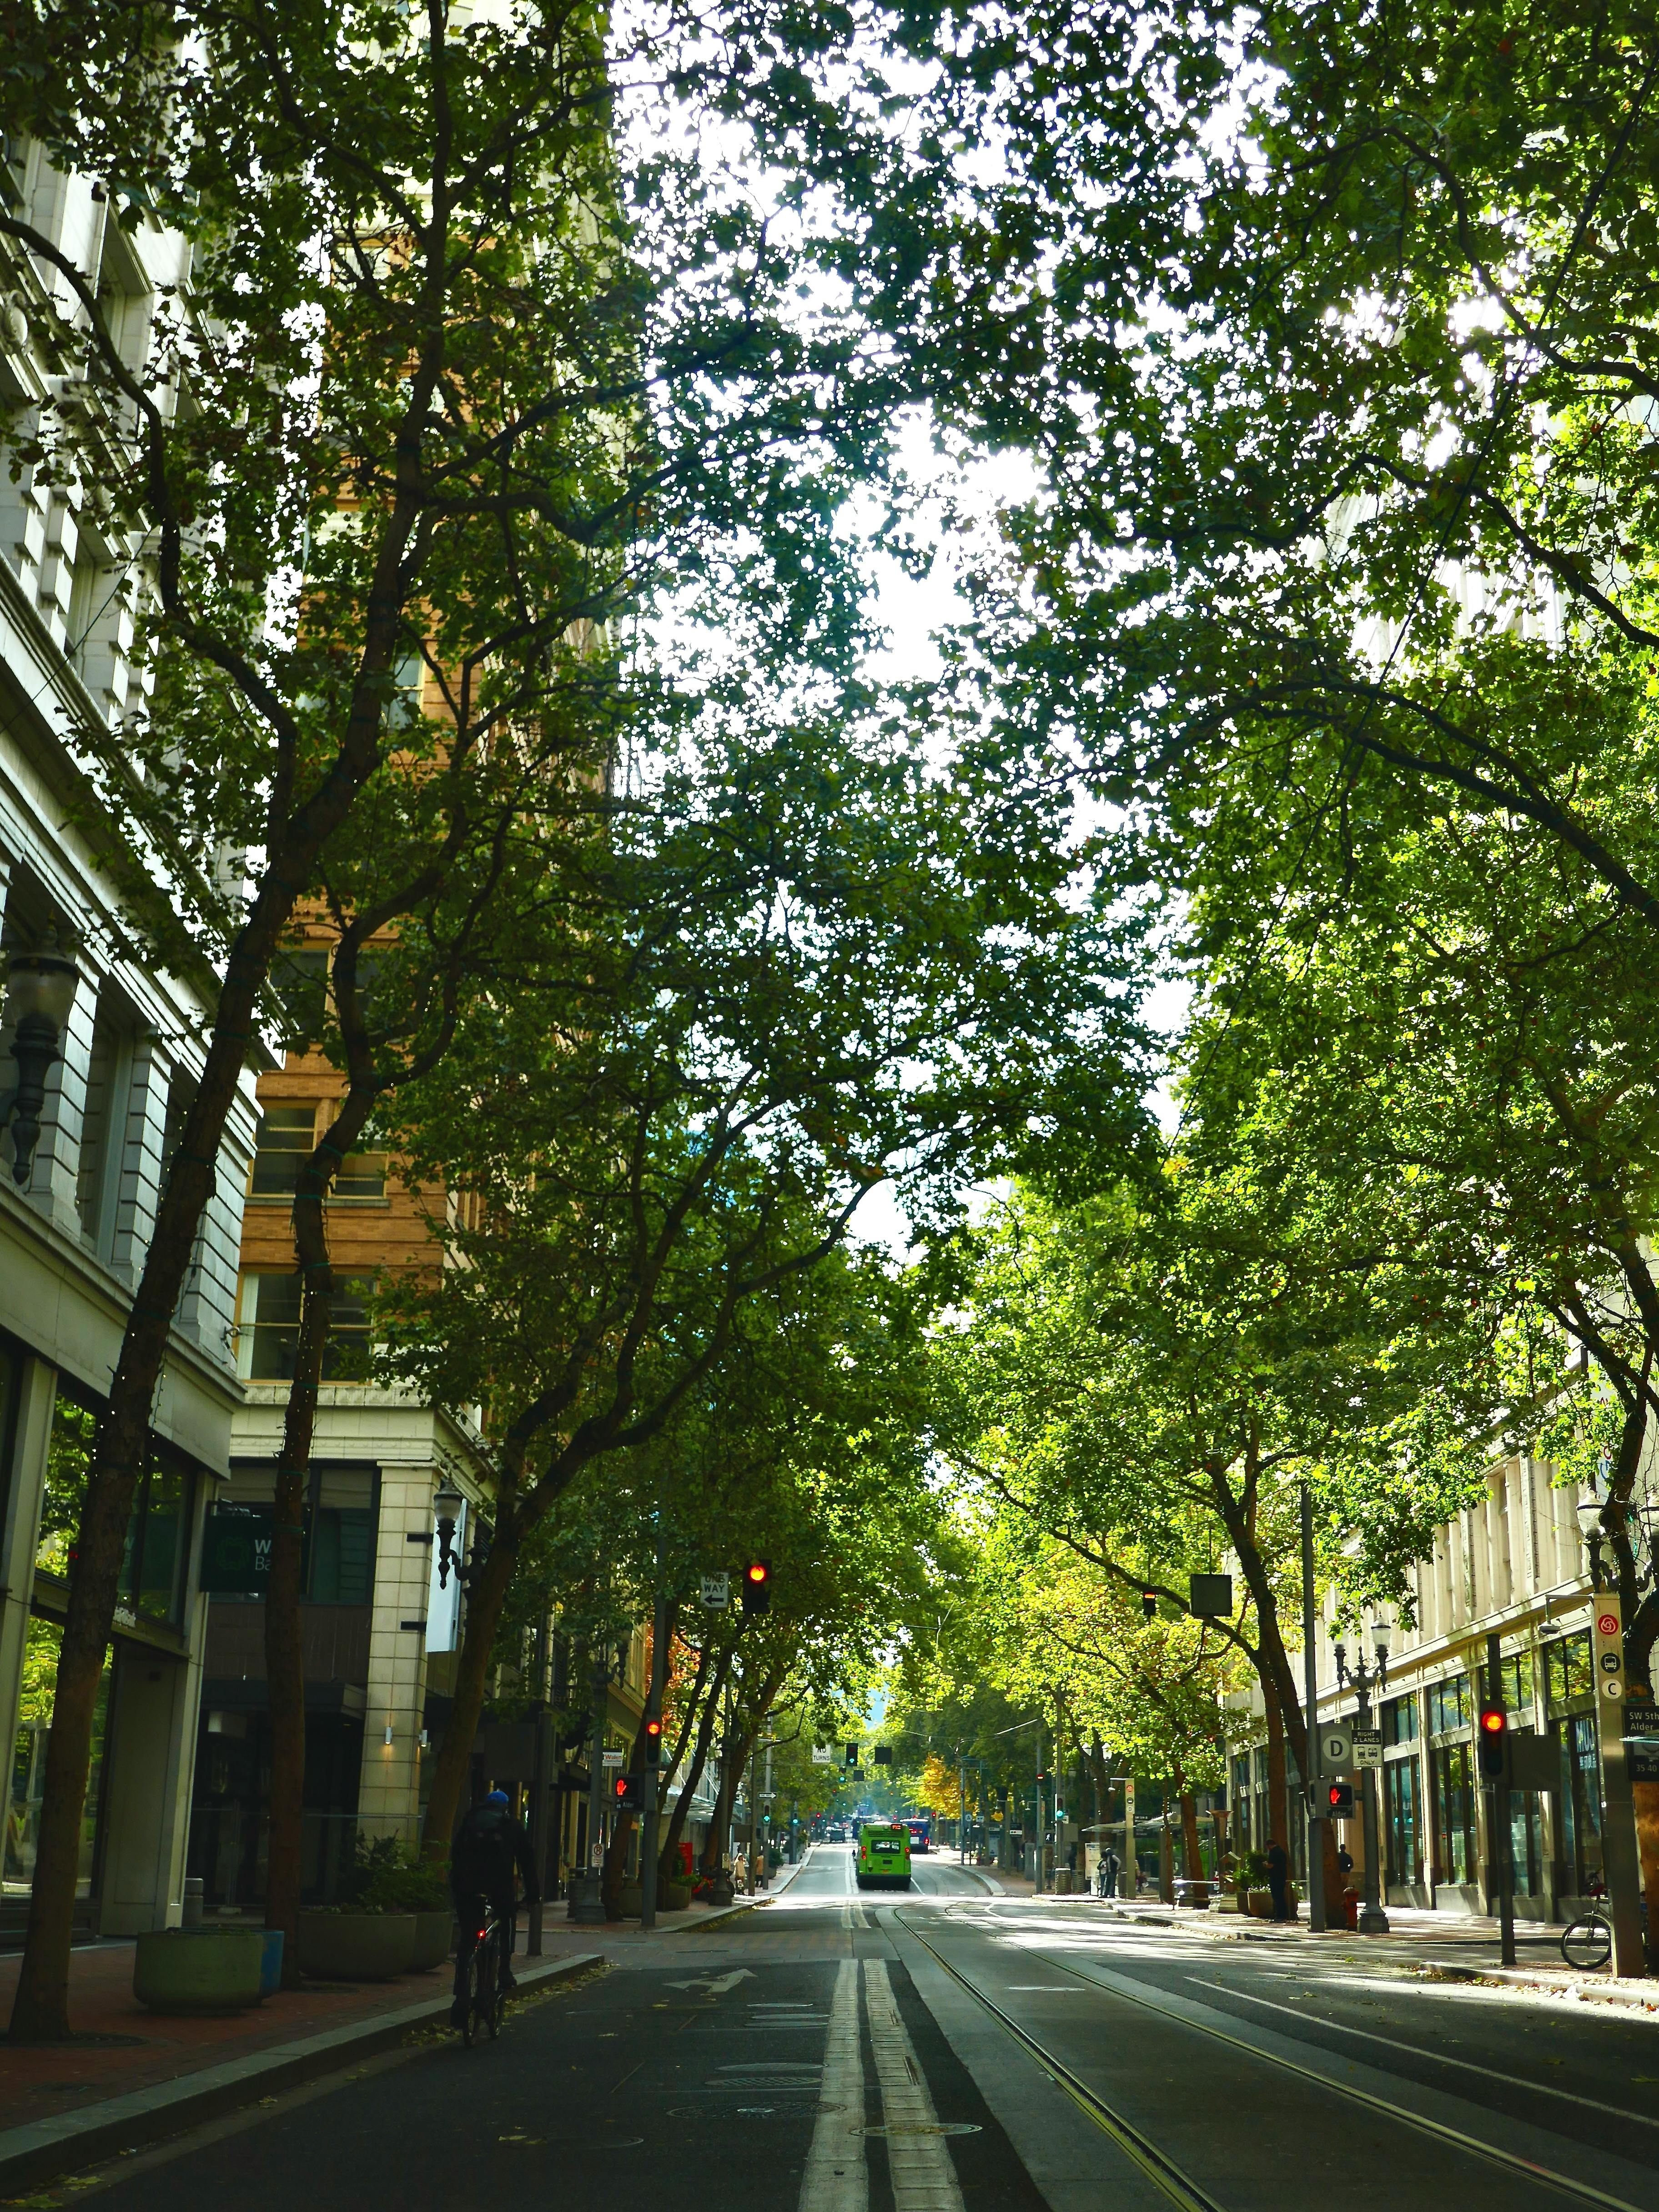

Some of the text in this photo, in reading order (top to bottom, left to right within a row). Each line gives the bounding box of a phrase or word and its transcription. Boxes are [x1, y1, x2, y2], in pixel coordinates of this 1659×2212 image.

[1608, 1683, 1617, 1695] C
[1330, 1740, 1343, 1757] D
[1636, 1764, 1657, 1772] 35 40
